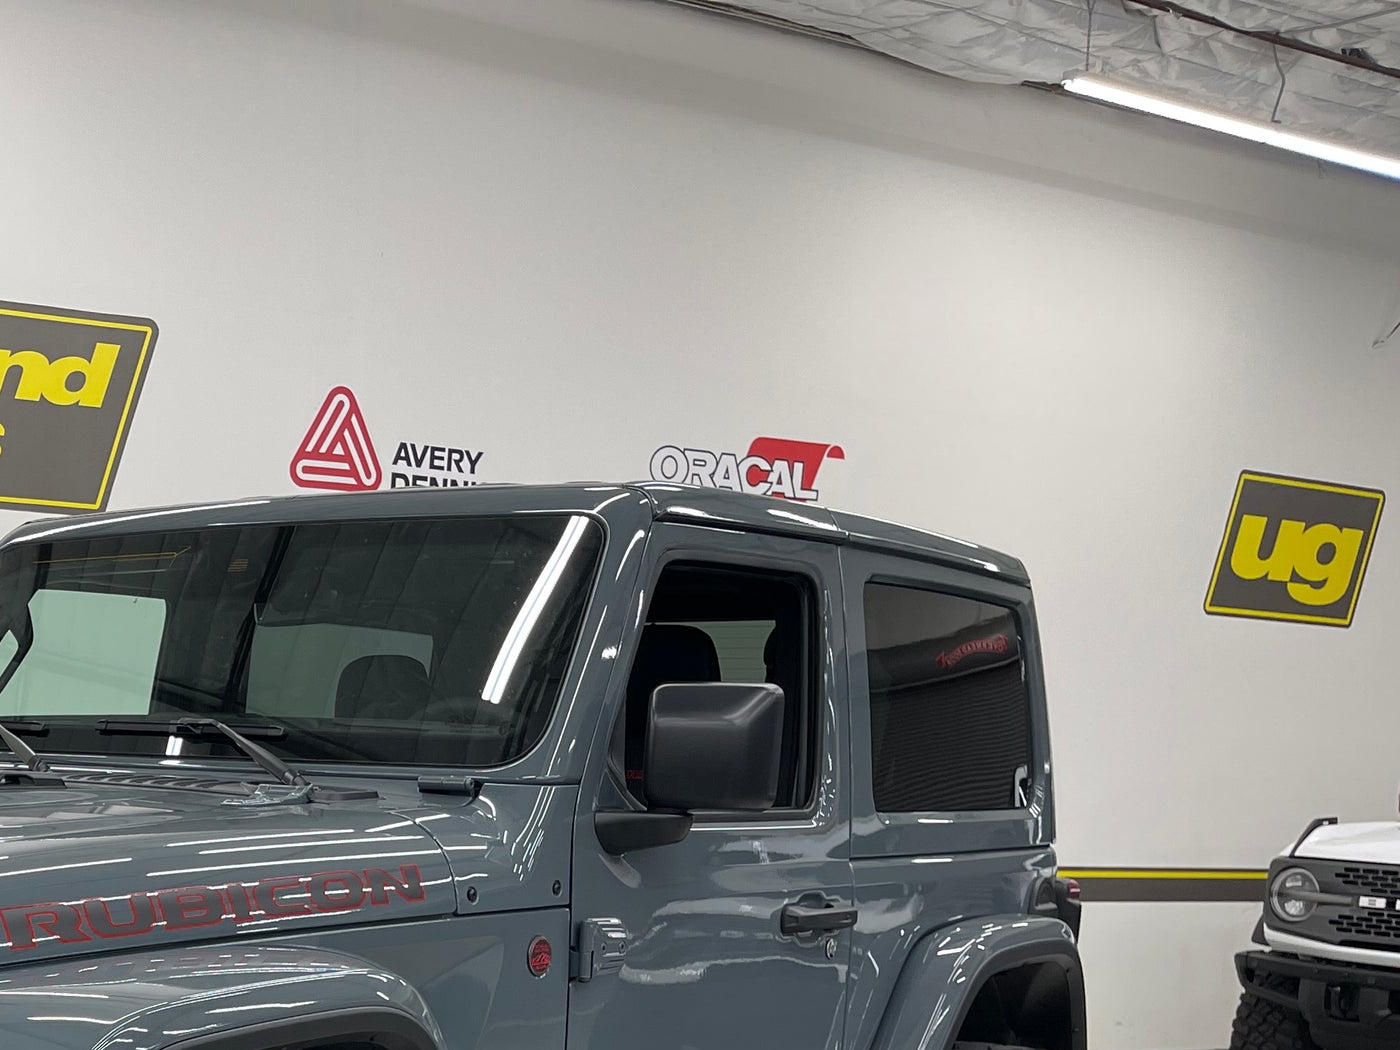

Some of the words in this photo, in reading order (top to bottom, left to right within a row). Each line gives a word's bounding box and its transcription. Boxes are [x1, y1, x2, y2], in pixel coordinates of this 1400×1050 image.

[392, 441, 484, 475] AVERY
[650, 444, 819, 501] ORACAL
[1231, 513, 1363, 606] ug
[0, 863, 426, 950] RUBICON
